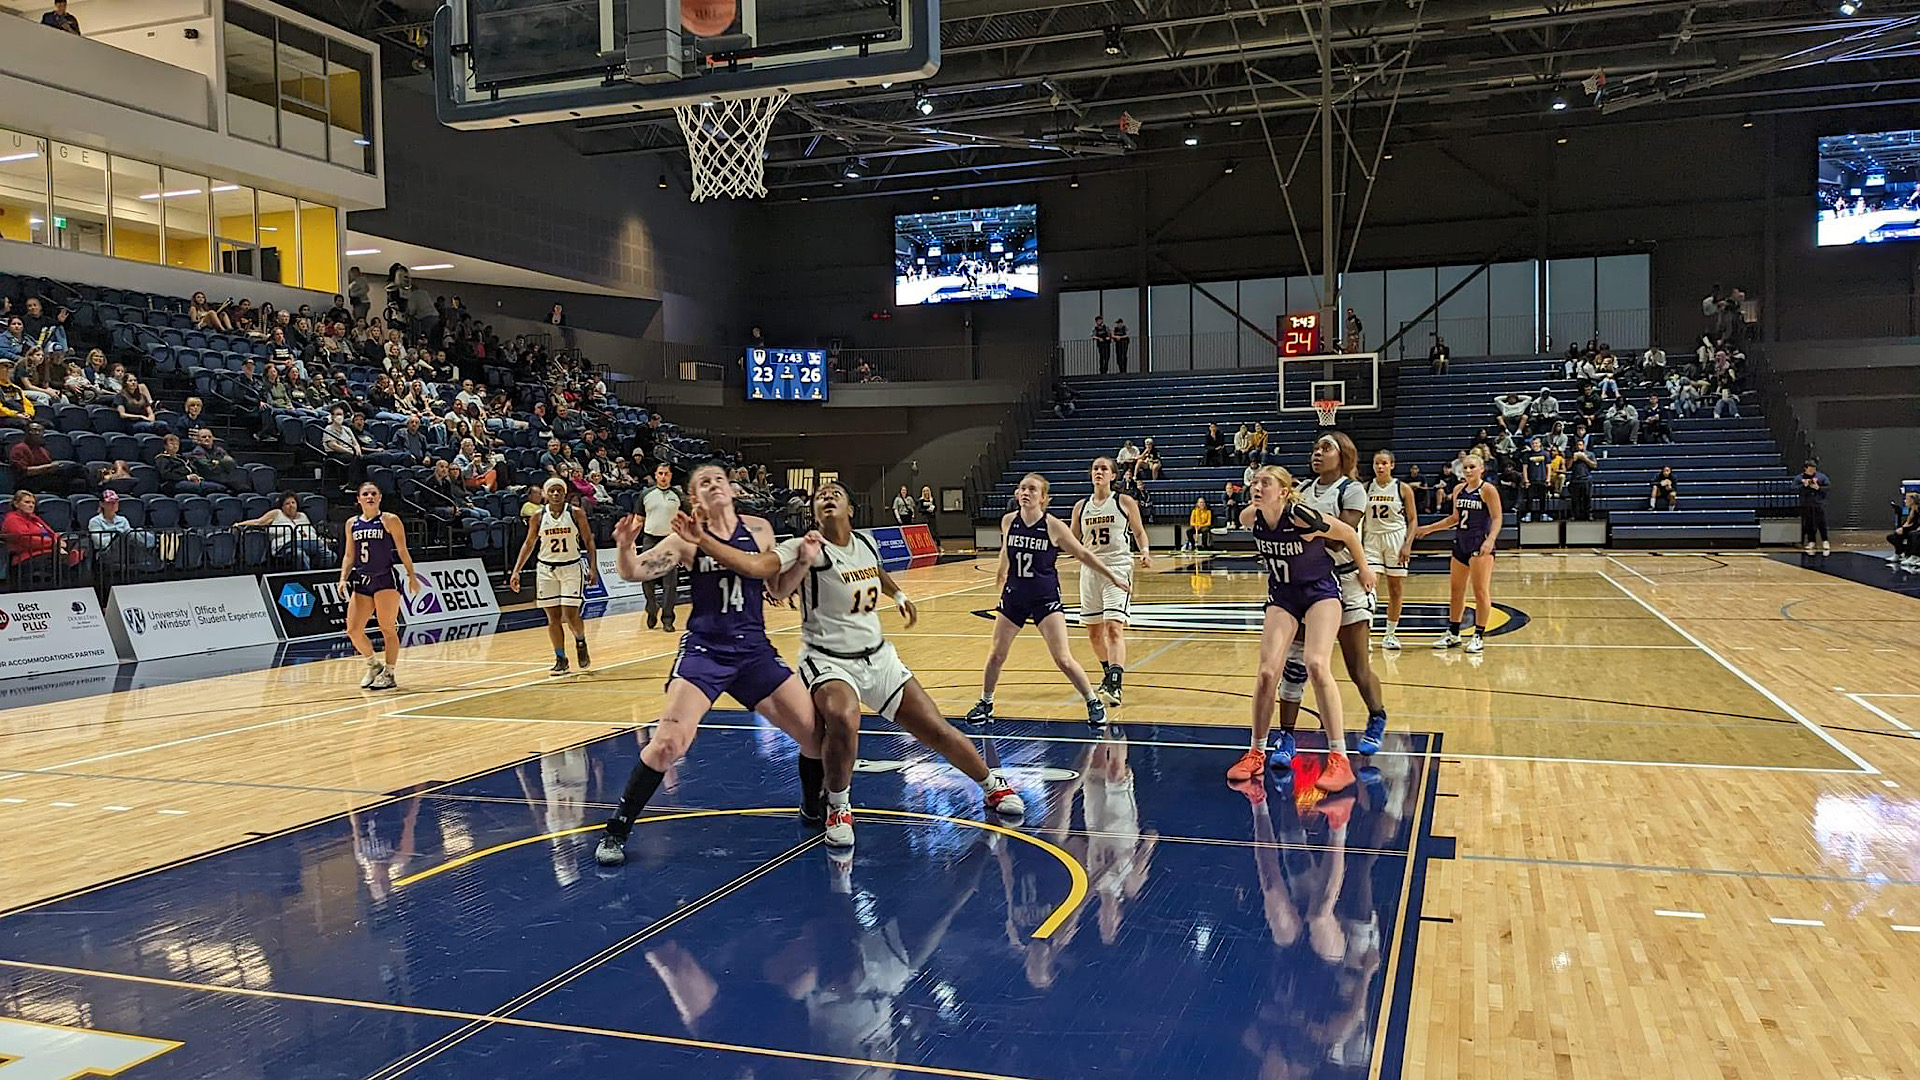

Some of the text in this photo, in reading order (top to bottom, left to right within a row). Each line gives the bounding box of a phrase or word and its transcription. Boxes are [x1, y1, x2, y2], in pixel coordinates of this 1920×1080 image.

[1290, 315, 1316, 328] 7:43
[1286, 332, 1312, 354] 24
[776, 353, 803, 363] 7:43
[753, 366, 774, 382] 23
[800, 367, 821, 383] 26
[1371, 504, 1389, 519] 12
[1456, 498, 1483, 510] ESTERN
[1085, 515, 1115, 526] WINDSOR
[1460, 509, 1469, 529] 2
[352, 528, 384, 541] ESTERN
[544, 526, 572, 536] WINDSOR
[1090, 527, 1110, 546] 15
[550, 537, 569, 553] 21
[1007, 534, 1049, 551] WESTERN
[360, 541, 369, 563] 5
[1015, 552, 1034, 578] 12
[1269, 558, 1290, 583] 17
[431, 568, 480, 591] TACO
[284, 592, 308, 608] TCI
[442, 589, 489, 612] BELL
[719, 575, 744, 613] 14
[850, 586, 878, 614] 13
[17, 602, 40, 612] Best
[147, 608, 188, 621] University
[194, 603, 226, 616] Office of
[11, 611, 51, 622] Western
[158, 617, 191, 630] Windsor
[197, 610, 267, 625] Student Experience
[22, 620, 48, 632] PLUS
[8, 653, 75, 667] ACCOMMODATIONS
[75, 649, 105, 659] PARTNER
